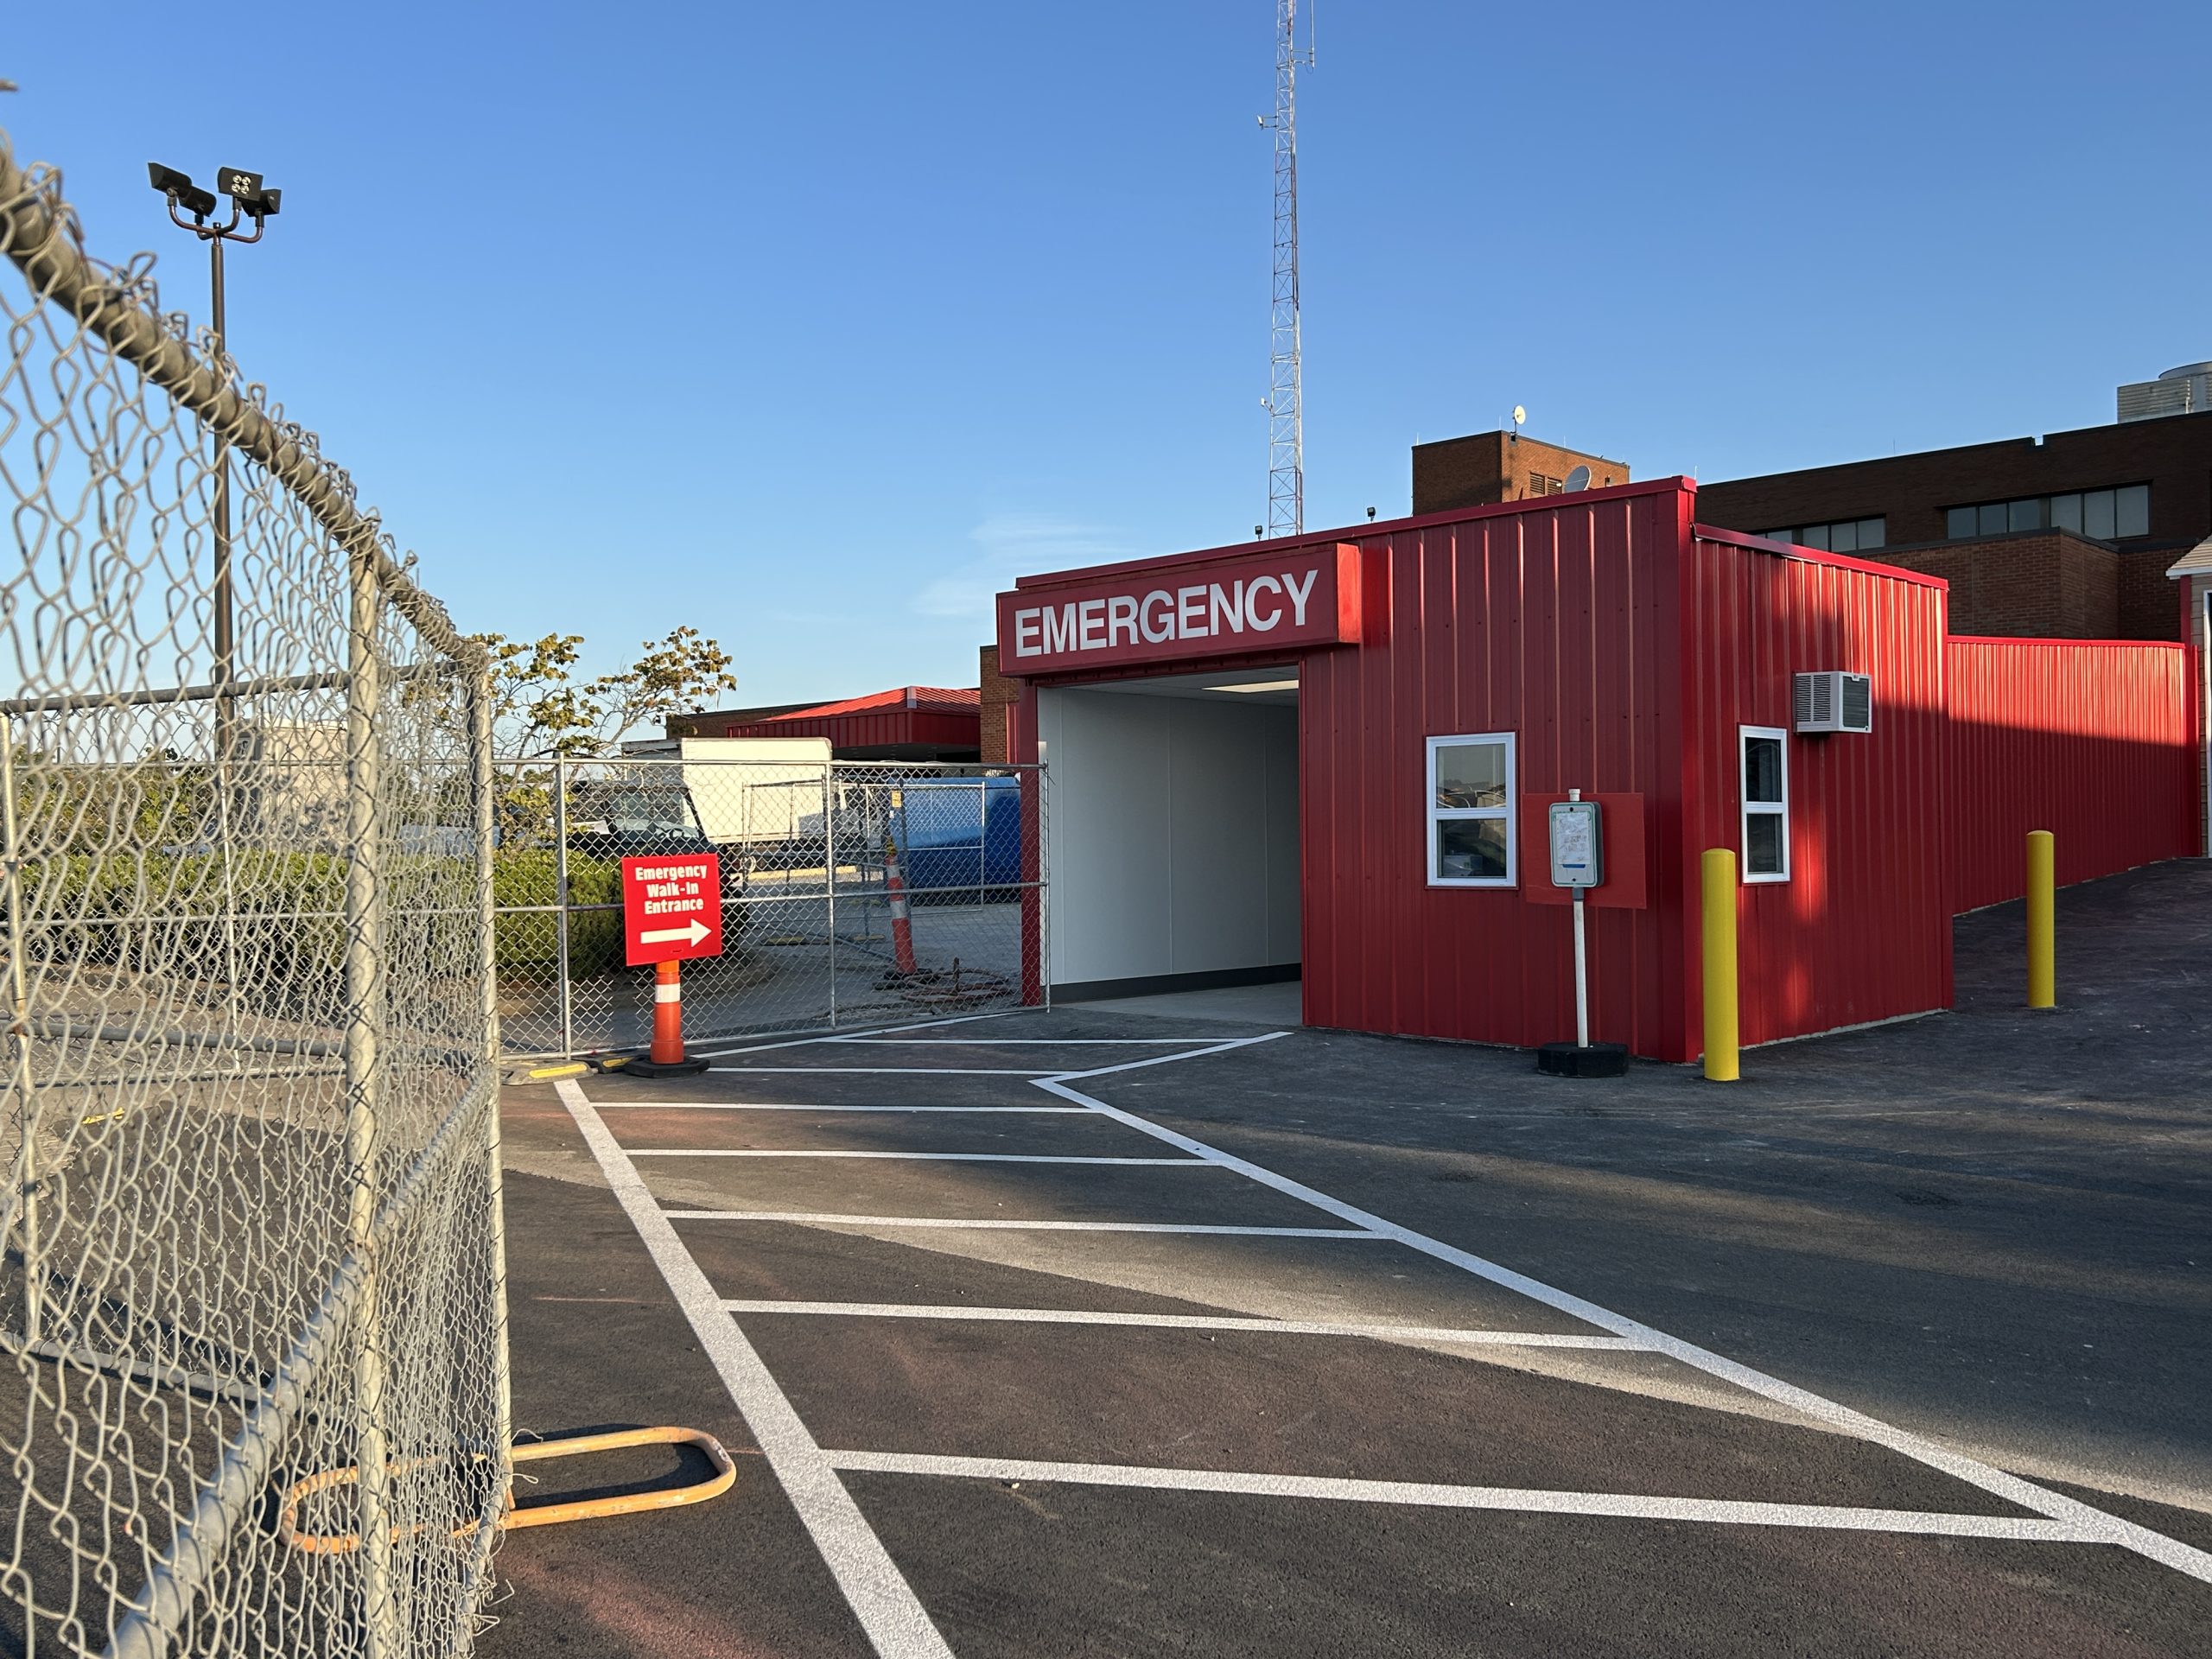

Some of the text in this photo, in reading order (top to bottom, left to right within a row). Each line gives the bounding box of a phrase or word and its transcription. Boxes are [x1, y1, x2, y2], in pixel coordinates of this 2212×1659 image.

[1015, 569, 1318, 658] EMERGENCY
[635, 865, 708, 881] Emergency
[646, 881, 700, 898] Walk-In
[644, 899, 704, 915] Entrance
